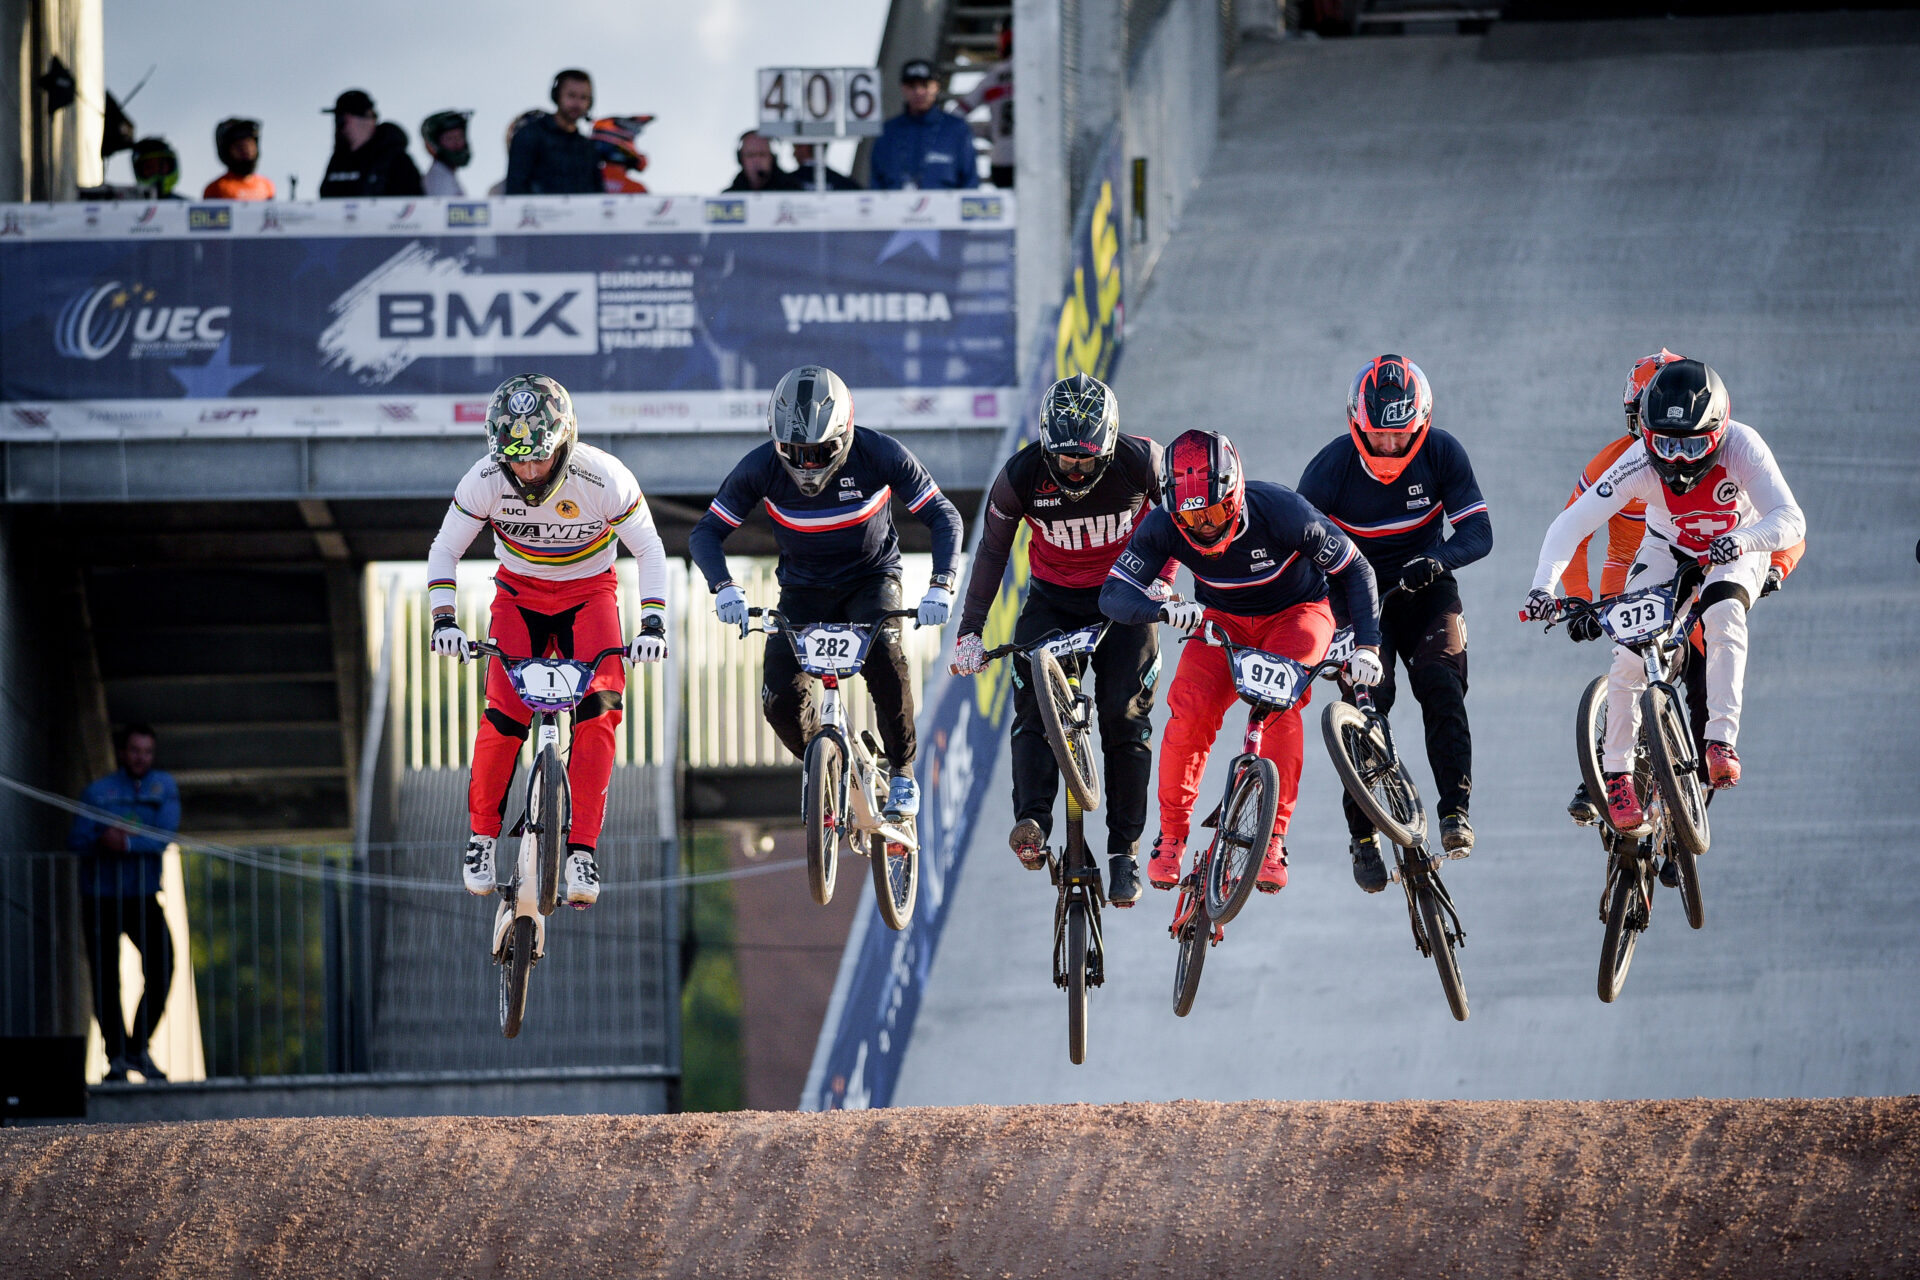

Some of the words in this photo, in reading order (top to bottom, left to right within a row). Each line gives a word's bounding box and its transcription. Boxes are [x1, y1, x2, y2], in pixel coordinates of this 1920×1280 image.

[765, 73, 874, 119] 406
[600, 271, 694, 288] EUROPEAN
[134, 306, 231, 340] UEC
[378, 292, 580, 339] BMX
[600, 304, 694, 329] 2019
[780, 291, 952, 334] VALMIERA
[506, 508, 527, 516] UCI
[1036, 509, 1134, 551] LATVIA
[1619, 603, 1656, 629] 373
[815, 637, 850, 658] 282
[546, 671, 555, 688] 1
[1251, 663, 1287, 690] 974
